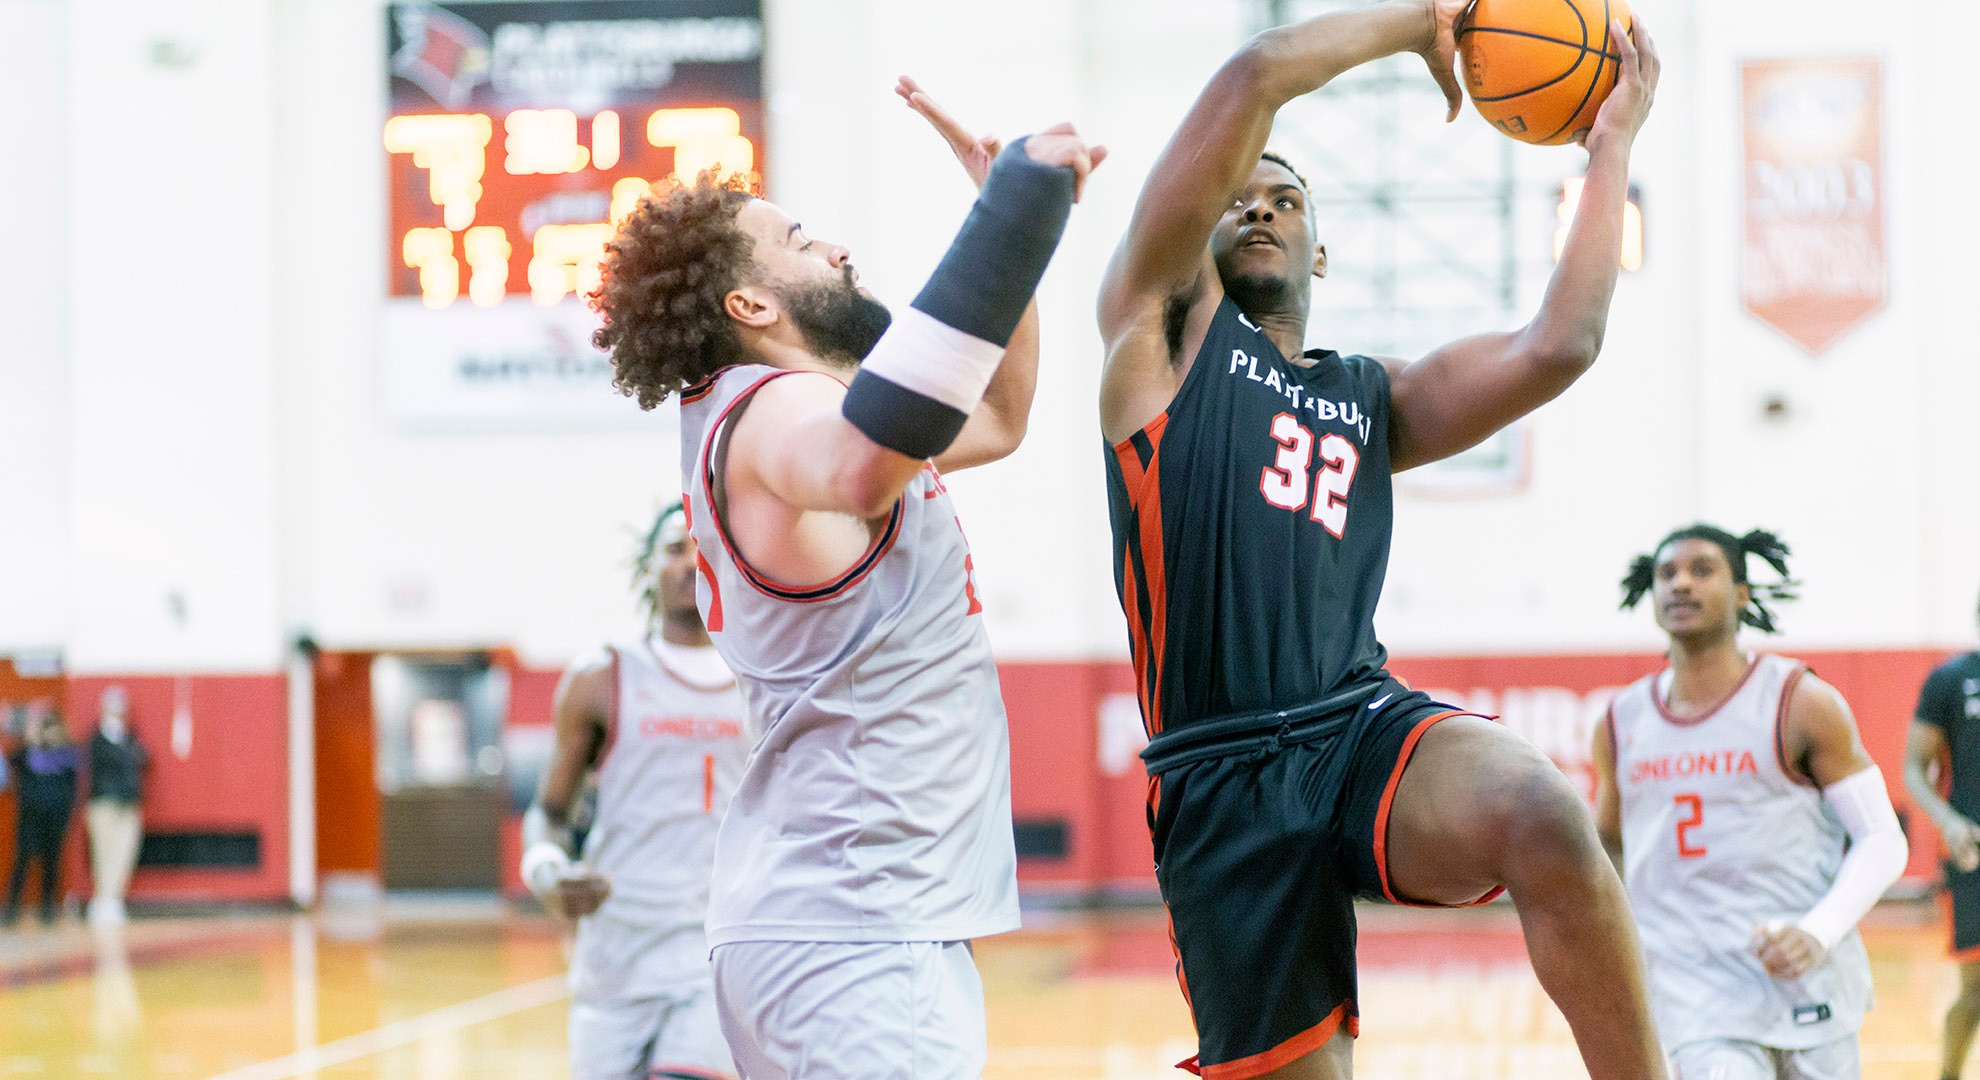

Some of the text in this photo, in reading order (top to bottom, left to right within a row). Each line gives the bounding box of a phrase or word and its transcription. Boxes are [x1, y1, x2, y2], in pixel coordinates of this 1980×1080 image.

[1259, 411, 1361, 541] 32
[703, 753, 715, 815] 1
[1630, 749, 1758, 785] ONEONTA
[1673, 793, 1708, 860] 2
